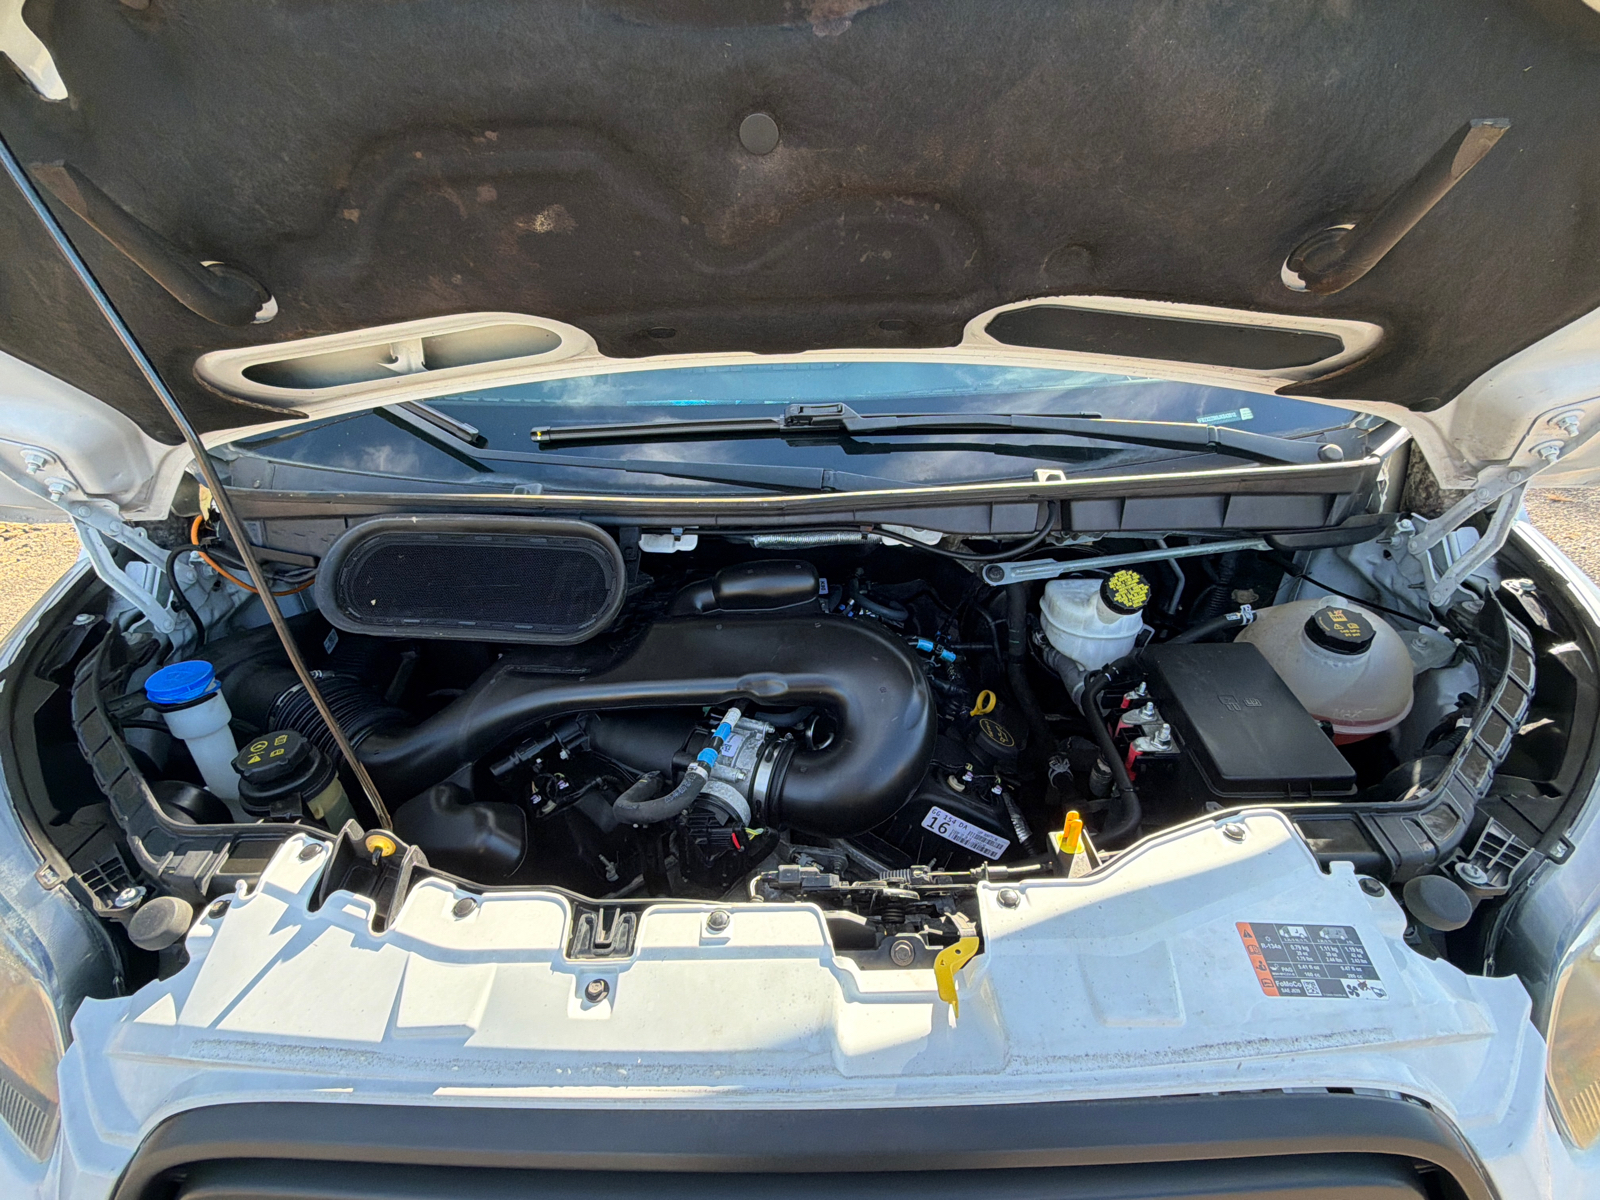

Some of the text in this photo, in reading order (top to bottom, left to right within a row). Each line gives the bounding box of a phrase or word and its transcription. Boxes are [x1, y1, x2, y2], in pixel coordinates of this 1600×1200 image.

[926, 816, 950, 834] 16
[932, 808, 968, 831] GG 154 DA
